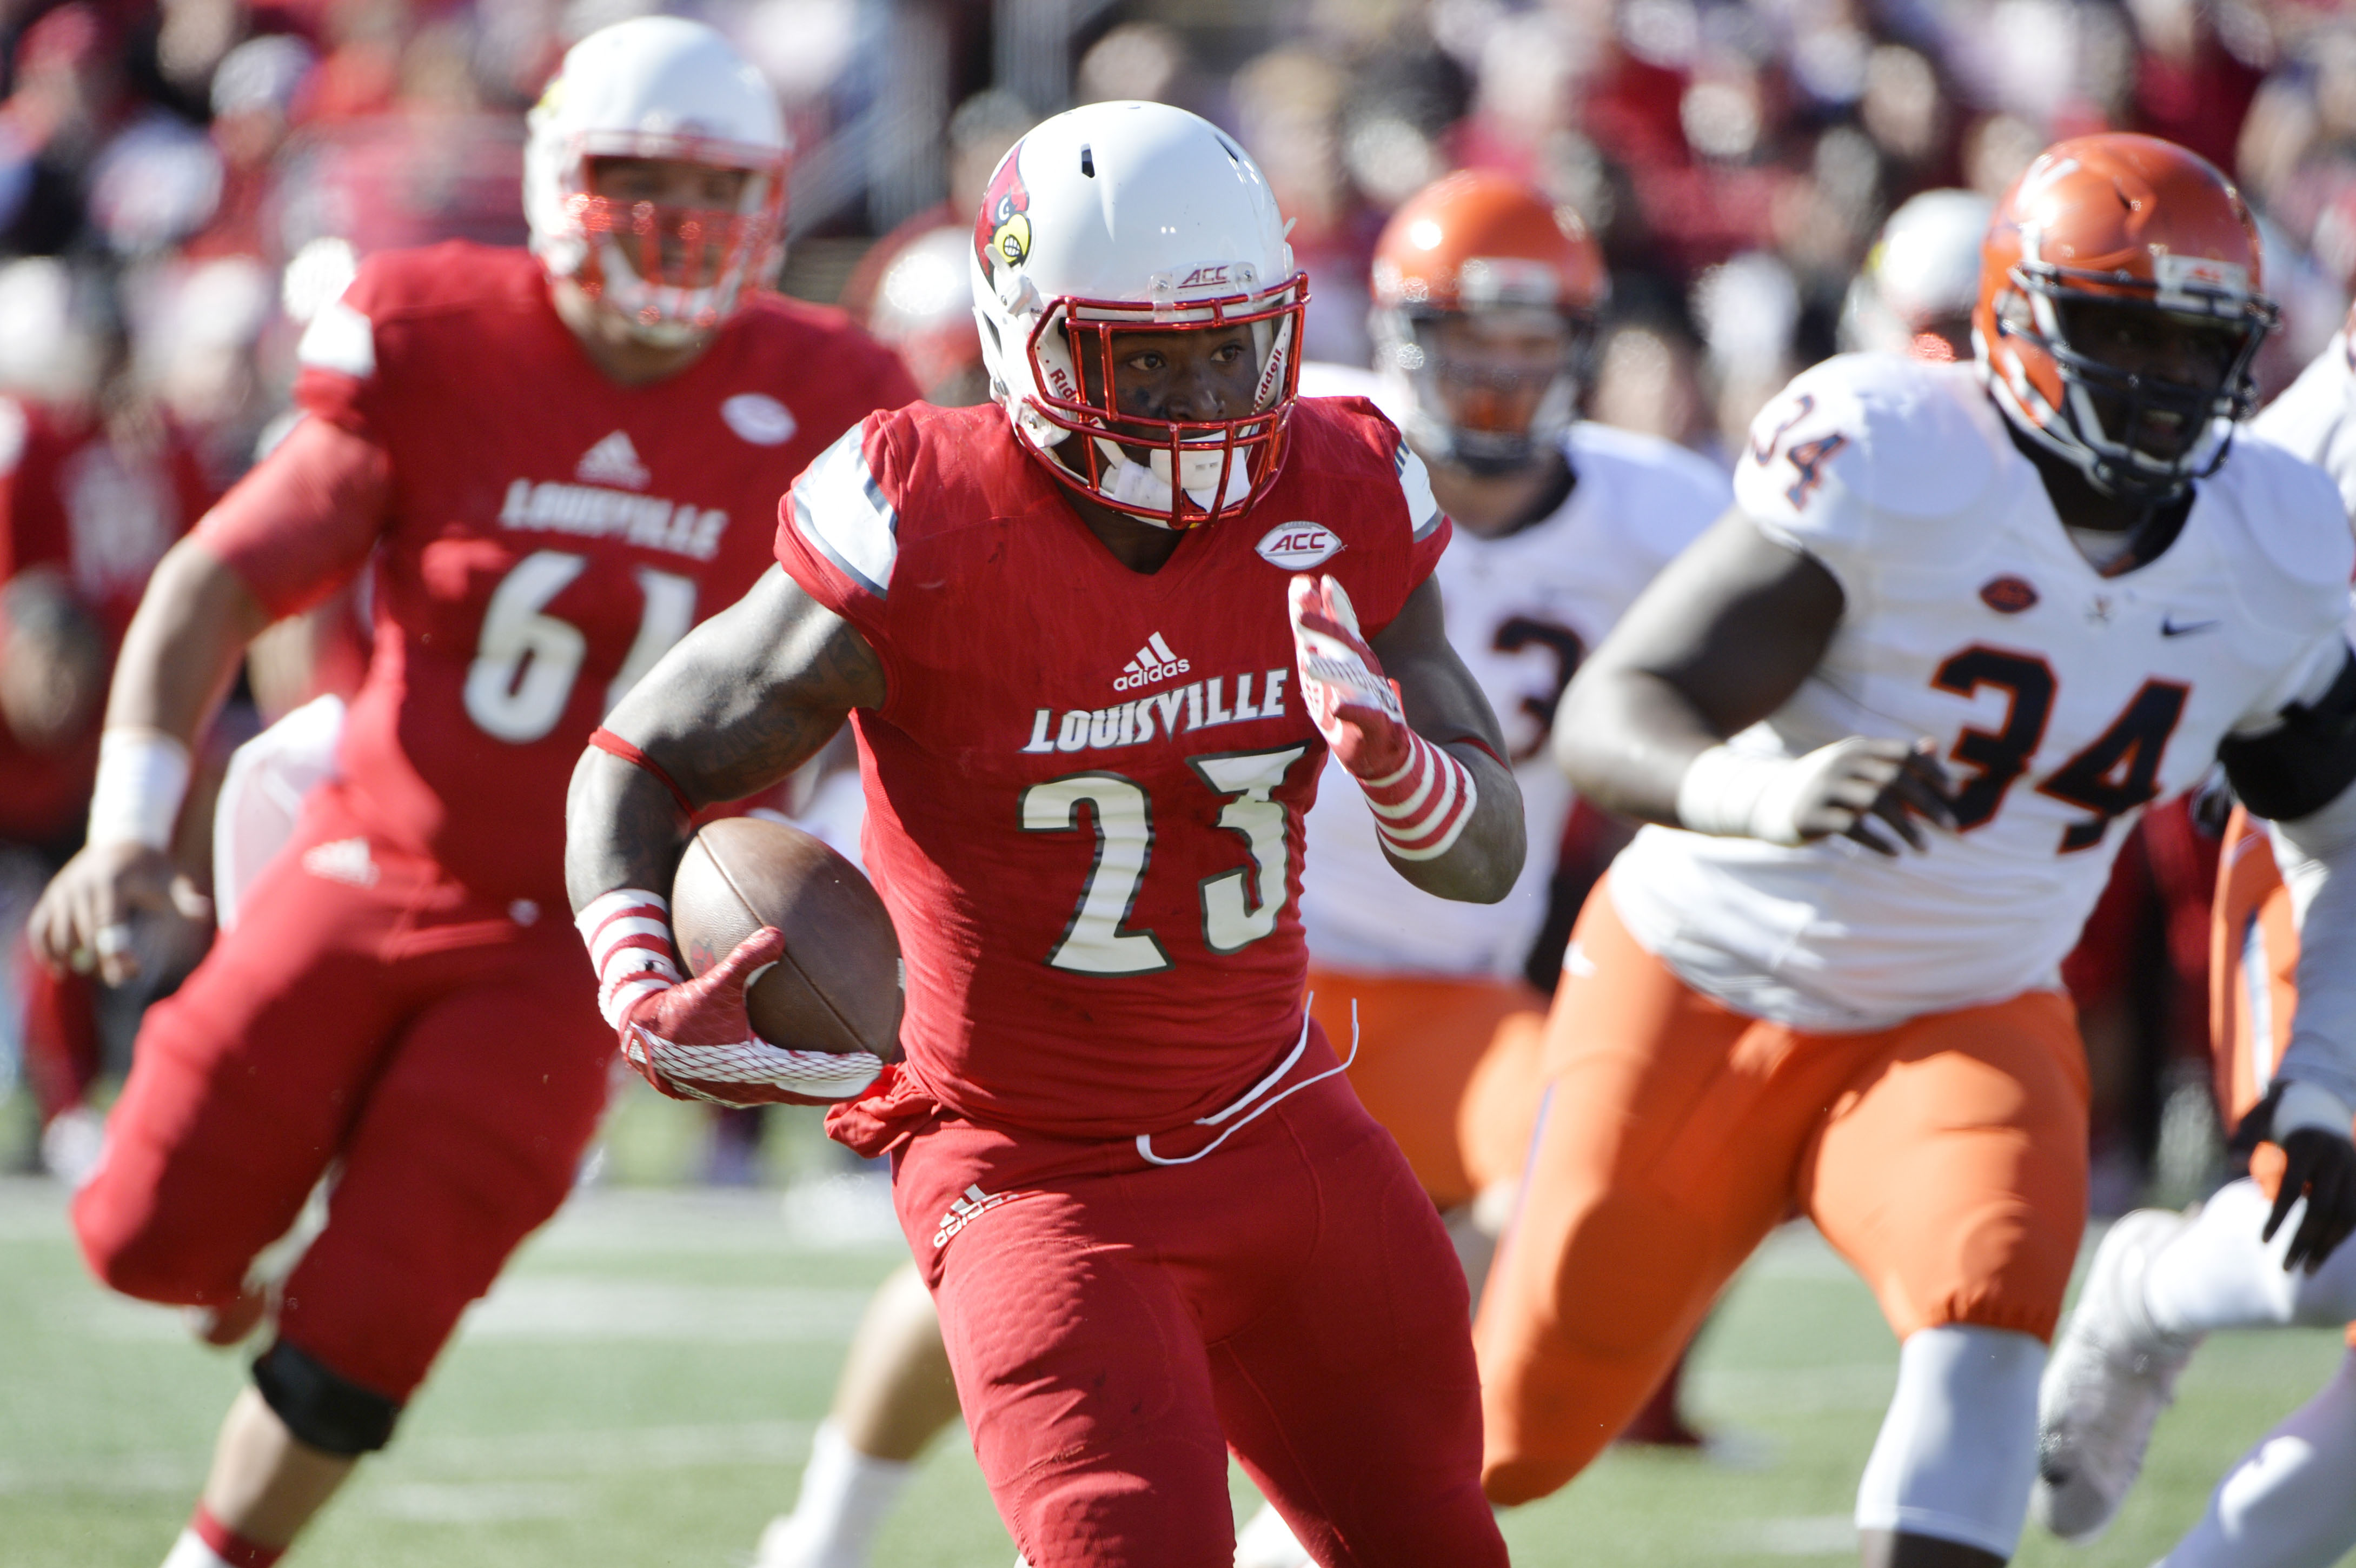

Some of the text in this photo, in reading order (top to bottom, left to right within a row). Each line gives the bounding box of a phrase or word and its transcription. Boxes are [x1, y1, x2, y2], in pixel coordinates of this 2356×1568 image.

[1182, 265, 1229, 284] ACC
[1269, 532, 1328, 552] ACC
[1113, 657, 1190, 692] adidas
[1017, 667, 1289, 754] LOUISVILLE
[1929, 641, 2193, 855] 34
[1017, 739, 1312, 978] 23
